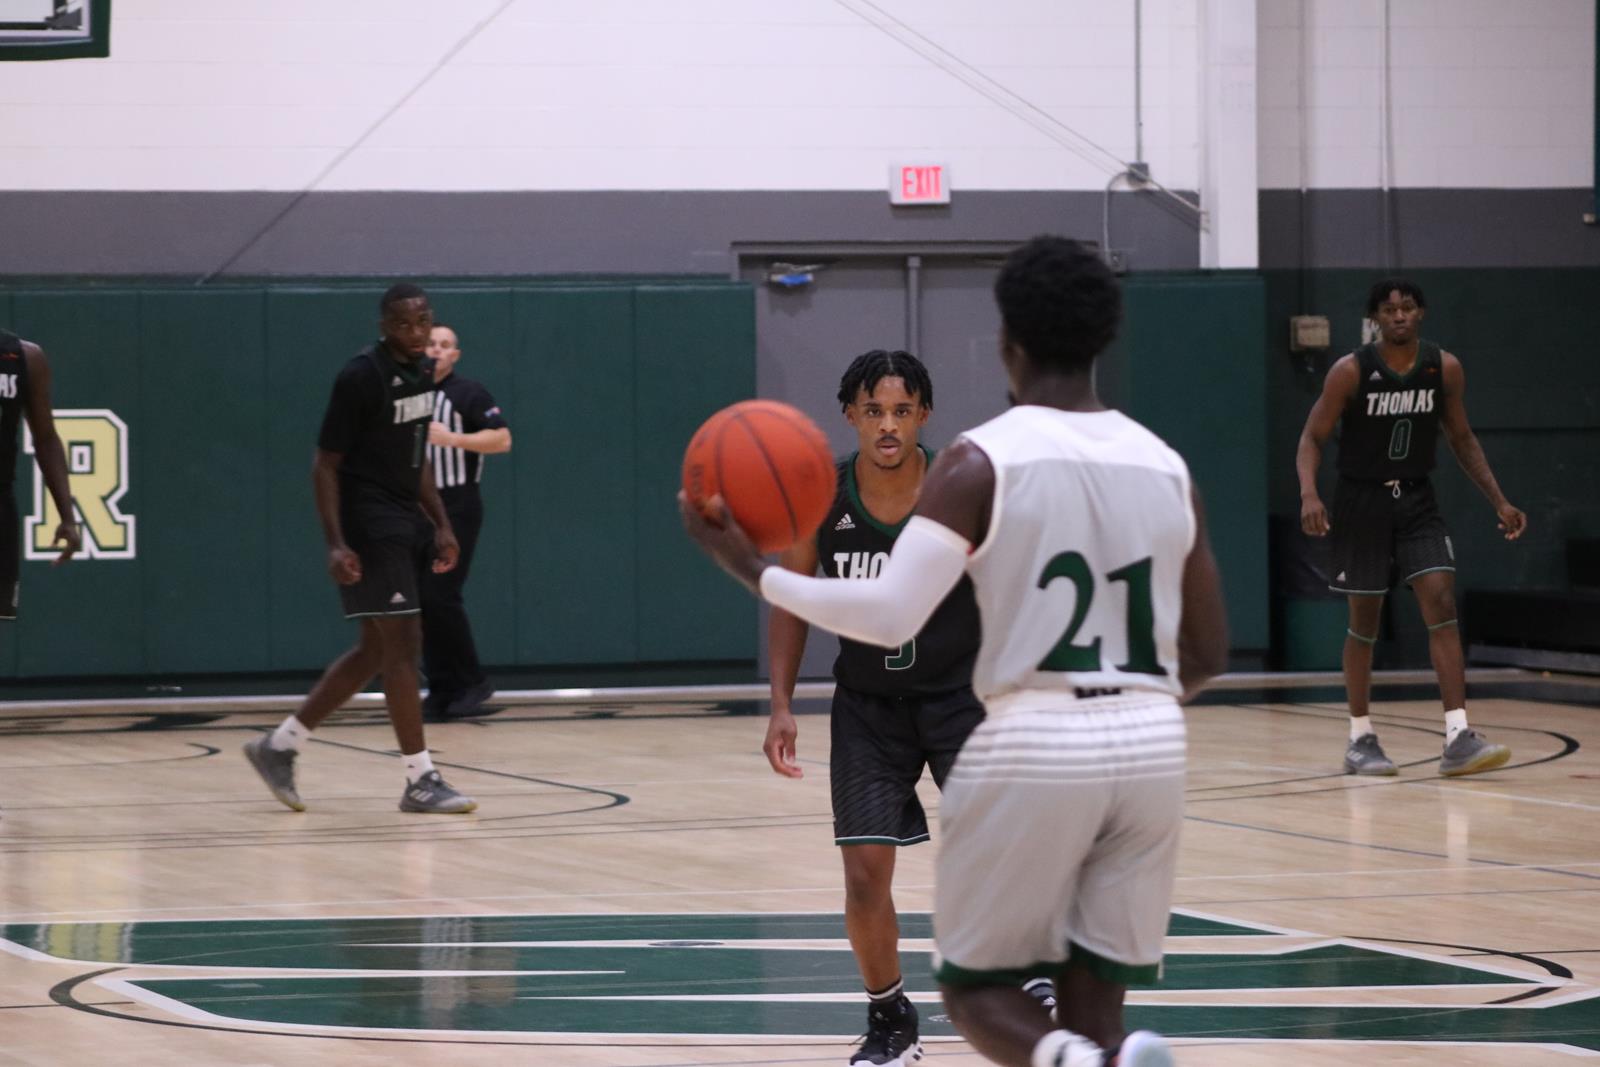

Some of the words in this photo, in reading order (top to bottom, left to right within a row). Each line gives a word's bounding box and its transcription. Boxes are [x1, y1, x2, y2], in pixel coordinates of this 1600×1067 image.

[901, 166, 942, 200] EXIT
[1366, 388, 1435, 416] THOMAS
[1388, 418, 1412, 460] 0
[24, 408, 136, 560] R
[1036, 550, 1168, 676] 21
